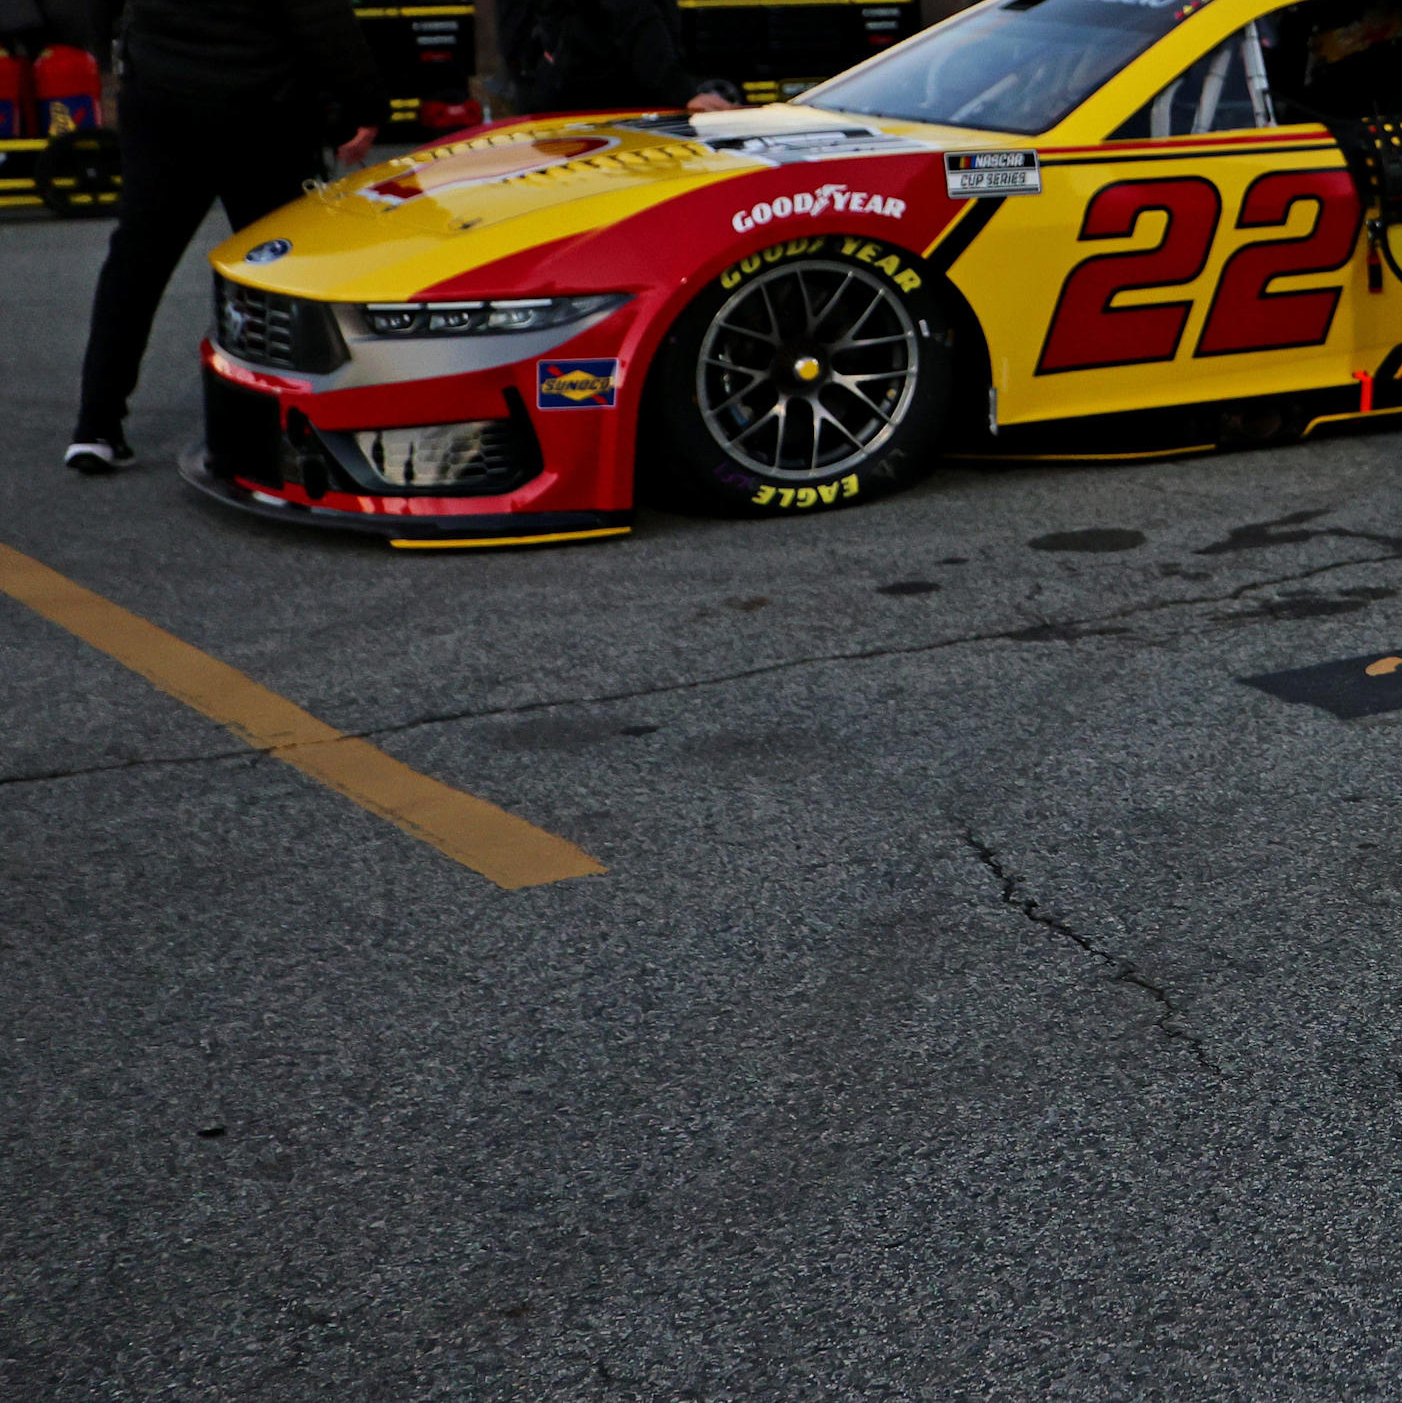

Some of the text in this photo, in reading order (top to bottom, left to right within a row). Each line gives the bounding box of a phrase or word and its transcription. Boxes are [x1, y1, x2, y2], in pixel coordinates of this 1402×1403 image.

[974, 153, 1025, 168] NASCAR
[960, 172, 1026, 187] CUP SERIES
[1034, 169, 1366, 376] 22
[543, 377, 611, 393] SUNOCO
[751, 472, 860, 508] EAGLE
